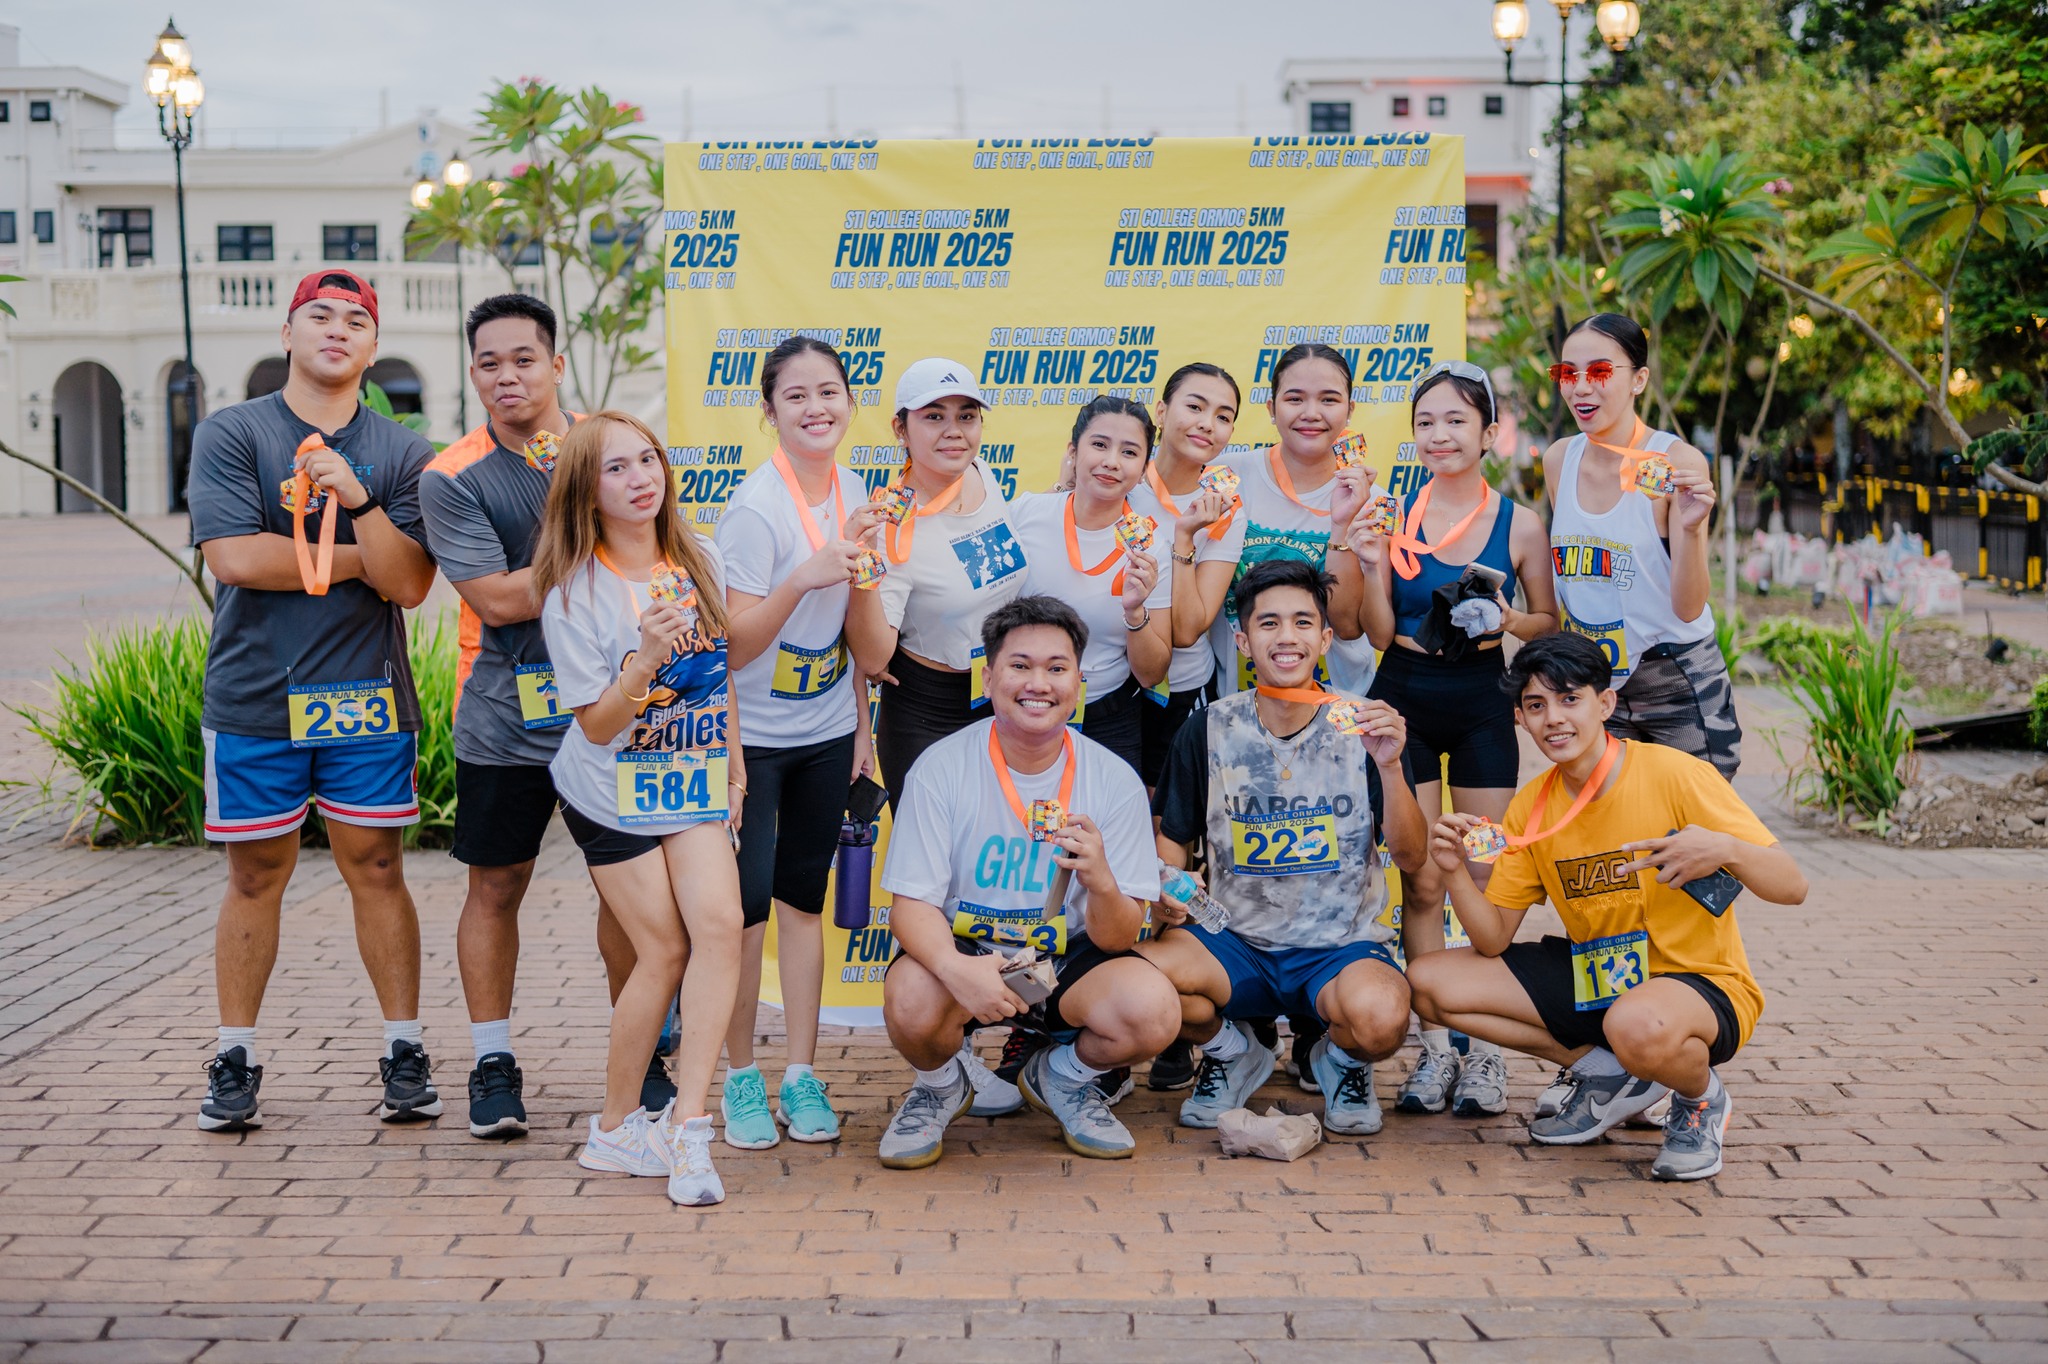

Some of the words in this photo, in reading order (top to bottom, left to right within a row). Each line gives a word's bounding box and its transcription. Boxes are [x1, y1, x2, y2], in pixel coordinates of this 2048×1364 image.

[699, 153, 724, 170] ONE
[726, 153, 761, 172] STEP,
[763, 153, 789, 170] ONE
[791, 153, 827, 171] GOAL,
[830, 152, 856, 170] ONE
[858, 152, 879, 170] STI
[973, 152, 999, 169] ONE
[1000, 152, 1036, 171] STEP,
[1038, 152, 1064, 169] ONE
[1066, 151, 1103, 170] GOAL,
[1106, 151, 1131, 168] ONE
[1133, 151, 1155, 168] STI
[1250, 150, 1275, 168] ONE
[1276, 150, 1313, 169] STEP,
[1314, 150, 1341, 167] ONE
[1342, 149, 1379, 168] GOAL,
[1382, 149, 1409, 167] ONE
[1409, 149, 1431, 166] STI
[664, 210, 697, 231] MOC
[699, 210, 736, 229] 5KM
[844, 209, 866, 230] STI
[866, 209, 922, 230] COLLEGE
[922, 209, 972, 229] ORMOC
[973, 208, 1010, 228] 5KM
[1118, 208, 1140, 228] STI
[1141, 208, 1197, 228] COLLEGE
[1197, 207, 1247, 227] ORMOC
[1248, 207, 1285, 227] 5KM
[1394, 206, 1417, 226] STI
[1417, 205, 1466, 225] COLLEG
[669, 233, 740, 268] 2025
[834, 233, 885, 268] FUN
[888, 232, 941, 267] RUN
[943, 232, 1014, 267] 2025
[1109, 231, 1159, 266] FUN
[1162, 231, 1216, 266] RUN
[1218, 230, 1290, 265] 2025
[1384, 229, 1435, 264] FUN
[1437, 228, 1466, 263] RU
[665, 272, 686, 291] AL,
[688, 272, 714, 289] ONE
[715, 272, 736, 289] STI
[830, 271, 856, 289] ONE
[857, 271, 894, 291] STEP,
[895, 271, 921, 288] ONE
[923, 271, 959, 290] GOAL,
[962, 271, 988, 288] ONE
[989, 271, 1011, 288] STI
[1104, 270, 1130, 287] ONE
[1131, 270, 1167, 289] STEP,
[1169, 270, 1196, 287] ONE
[1197, 269, 1234, 288] GOAL,
[1236, 269, 1262, 287] ONE
[1264, 269, 1285, 286] STI
[1379, 267, 1406, 285] ONE
[1407, 267, 1442, 286] STEP,
[716, 328, 739, 348] STI
[845, 327, 881, 347] 5KM
[989, 327, 1010, 347] STI
[1011, 327, 1067, 347] COLLEGE
[1067, 327, 1117, 346] ORMOC
[1118, 326, 1155, 346] 5KM
[1263, 325, 1286, 345] STI
[1286, 325, 1342, 345] COLLEGE
[1342, 325, 1391, 344] ORMOC
[1393, 324, 1430, 343] 5KM
[707, 352, 757, 386] FUN
[840, 351, 885, 385] 25
[980, 350, 1029, 385] FUN
[1033, 350, 1086, 384] RUN
[1088, 350, 1159, 384] 2025
[1254, 348, 1287, 383] FU
[1363, 347, 1434, 382] 2025
[704, 389, 727, 407] ONE
[861, 389, 881, 407] STI
[1003, 388, 1037, 408] STEP,
[1040, 388, 1066, 406] ONE
[1068, 388, 1099, 405] GOA
[1134, 388, 1155, 405] STI
[1351, 386, 1378, 405] OAL,
[1381, 386, 1407, 403] ONE
[667, 447, 704, 466] RMOC
[706, 445, 743, 465] 5KM
[849, 445, 872, 465] STI
[872, 445, 907, 465] COLL
[979, 444, 1015, 464] 5KM
[1396, 442, 1418, 462] STI
[696, 507, 721, 525] ONE
[1563, 535, 1602, 547] COLLEGE
[1602, 537, 1633, 554] ORMOC
[1581, 545, 1612, 578] RUN
[796, 655, 816, 663] FUN
[535, 672, 555, 680] FUN
[294, 685, 309, 693] STI
[312, 683, 355, 692] COLLEGE
[357, 680, 388, 688] ORMOC
[307, 692, 328, 701] FUN
[330, 691, 351, 700] RUN
[354, 689, 378, 698] 2025
[709, 693, 728, 708] 202
[651, 699, 687, 730] Blue
[629, 710, 727, 752] Eagles
[635, 763, 657, 771] FUN
[660, 763, 673, 771] RU
[641, 753, 673, 761] COLLE
[634, 768, 711, 813] 584
[1244, 823, 1263, 831] FUN
[1265, 821, 1286, 830] RUN
[1289, 817, 1315, 827] 2025
[1246, 813, 1289, 823] COLLEGE
[1291, 807, 1328, 818] ORMOC
[973, 915, 995, 924] FUN
[980, 908, 1023, 918] COLLEGE
[845, 929, 894, 963] FUN
[1614, 933, 1642, 944] ORMOC
[1595, 948, 1611, 958] RUN
[1613, 943, 1633, 954] 2025
[841, 966, 865, 983] ONE
